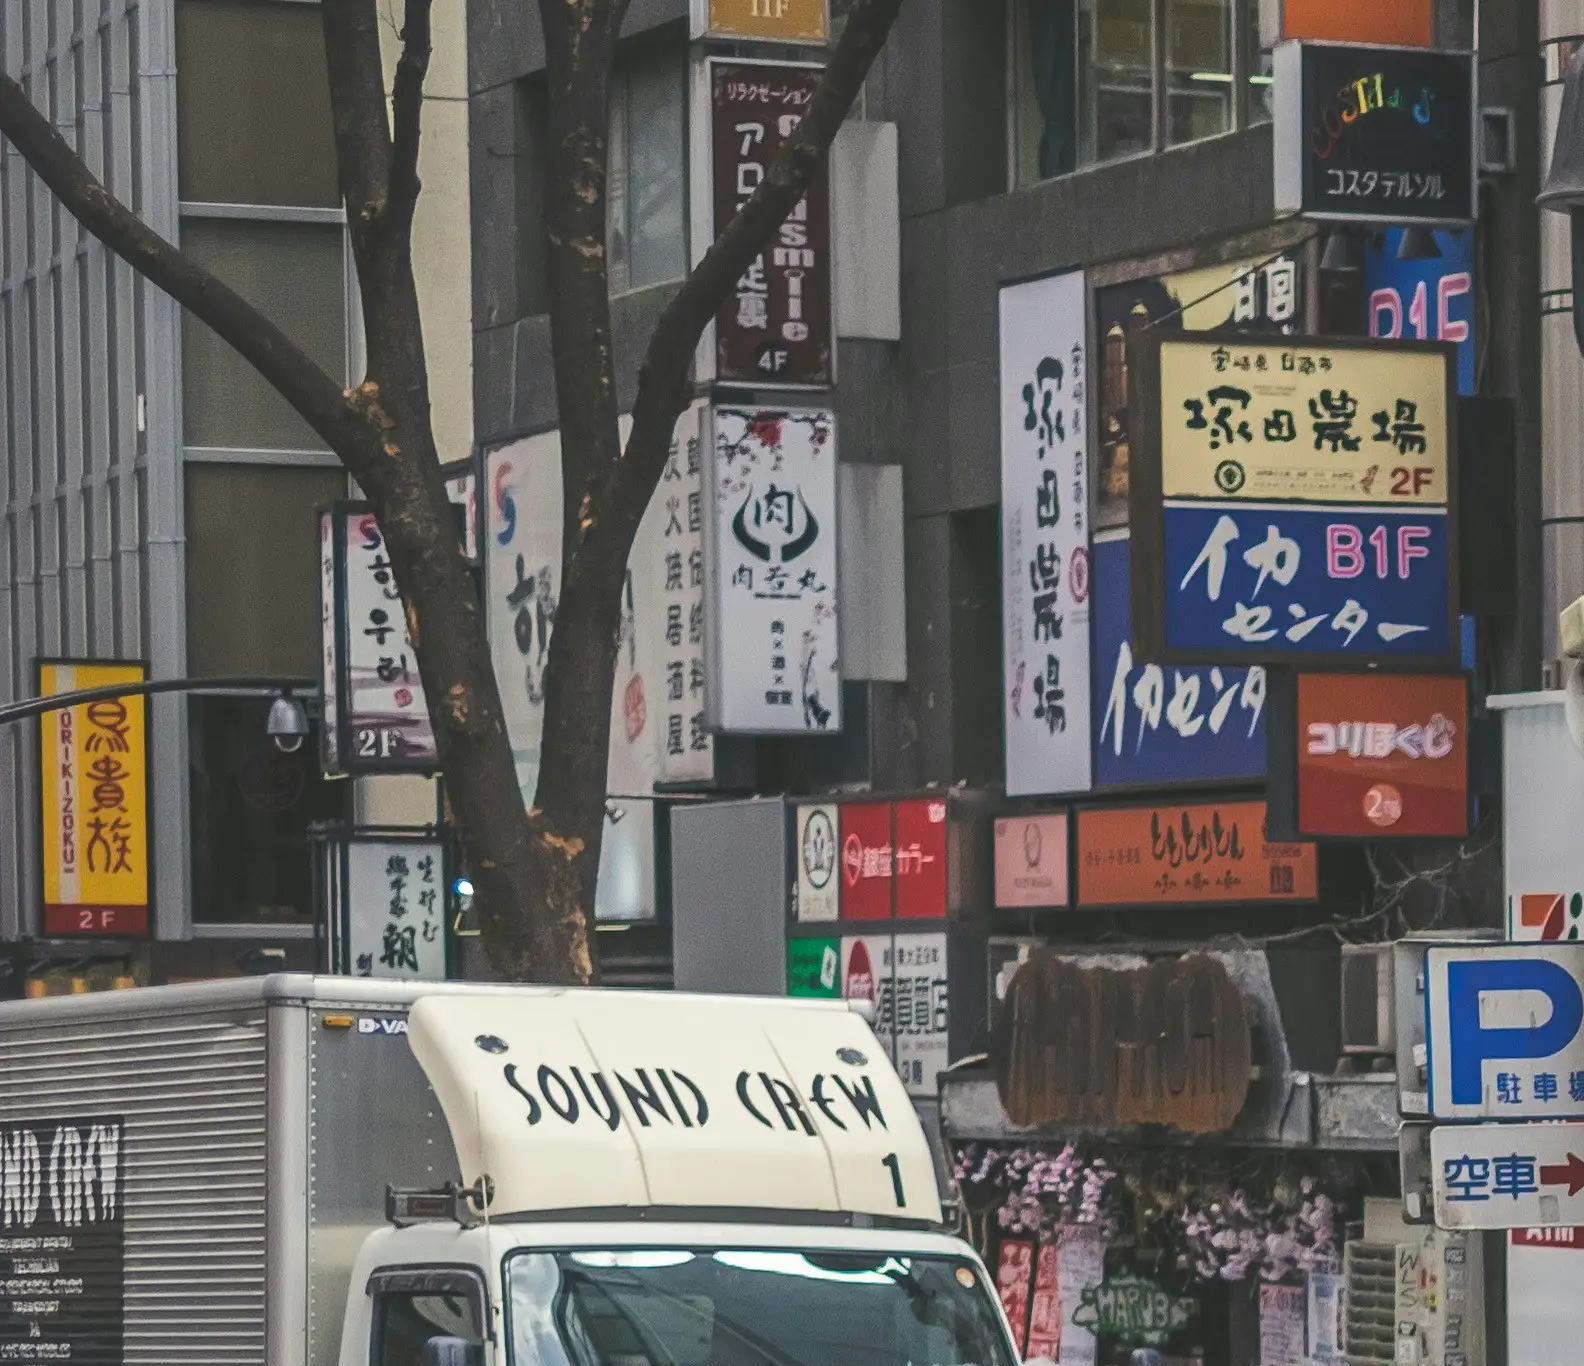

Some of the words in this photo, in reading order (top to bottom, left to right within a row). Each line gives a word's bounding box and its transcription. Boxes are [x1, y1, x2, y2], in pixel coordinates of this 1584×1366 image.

[758, 350, 788, 371] 4F
[1183, 385, 1427, 455] 塚田農場
[1389, 467, 1435, 496] 2F
[754, 484, 794, 534] 肉
[1180, 515, 1300, 601] イカ
[1327, 524, 1431, 579] B1F
[1222, 599, 1430, 648] センター
[358, 729, 402, 758] 2F
[1447, 959, 1584, 1106] P
[504, 1062, 709, 1131] SOUND
[737, 1071, 889, 1138] CREW
[881, 1153, 908, 1207] 1
[1444, 1153, 1539, 1202] 空車
